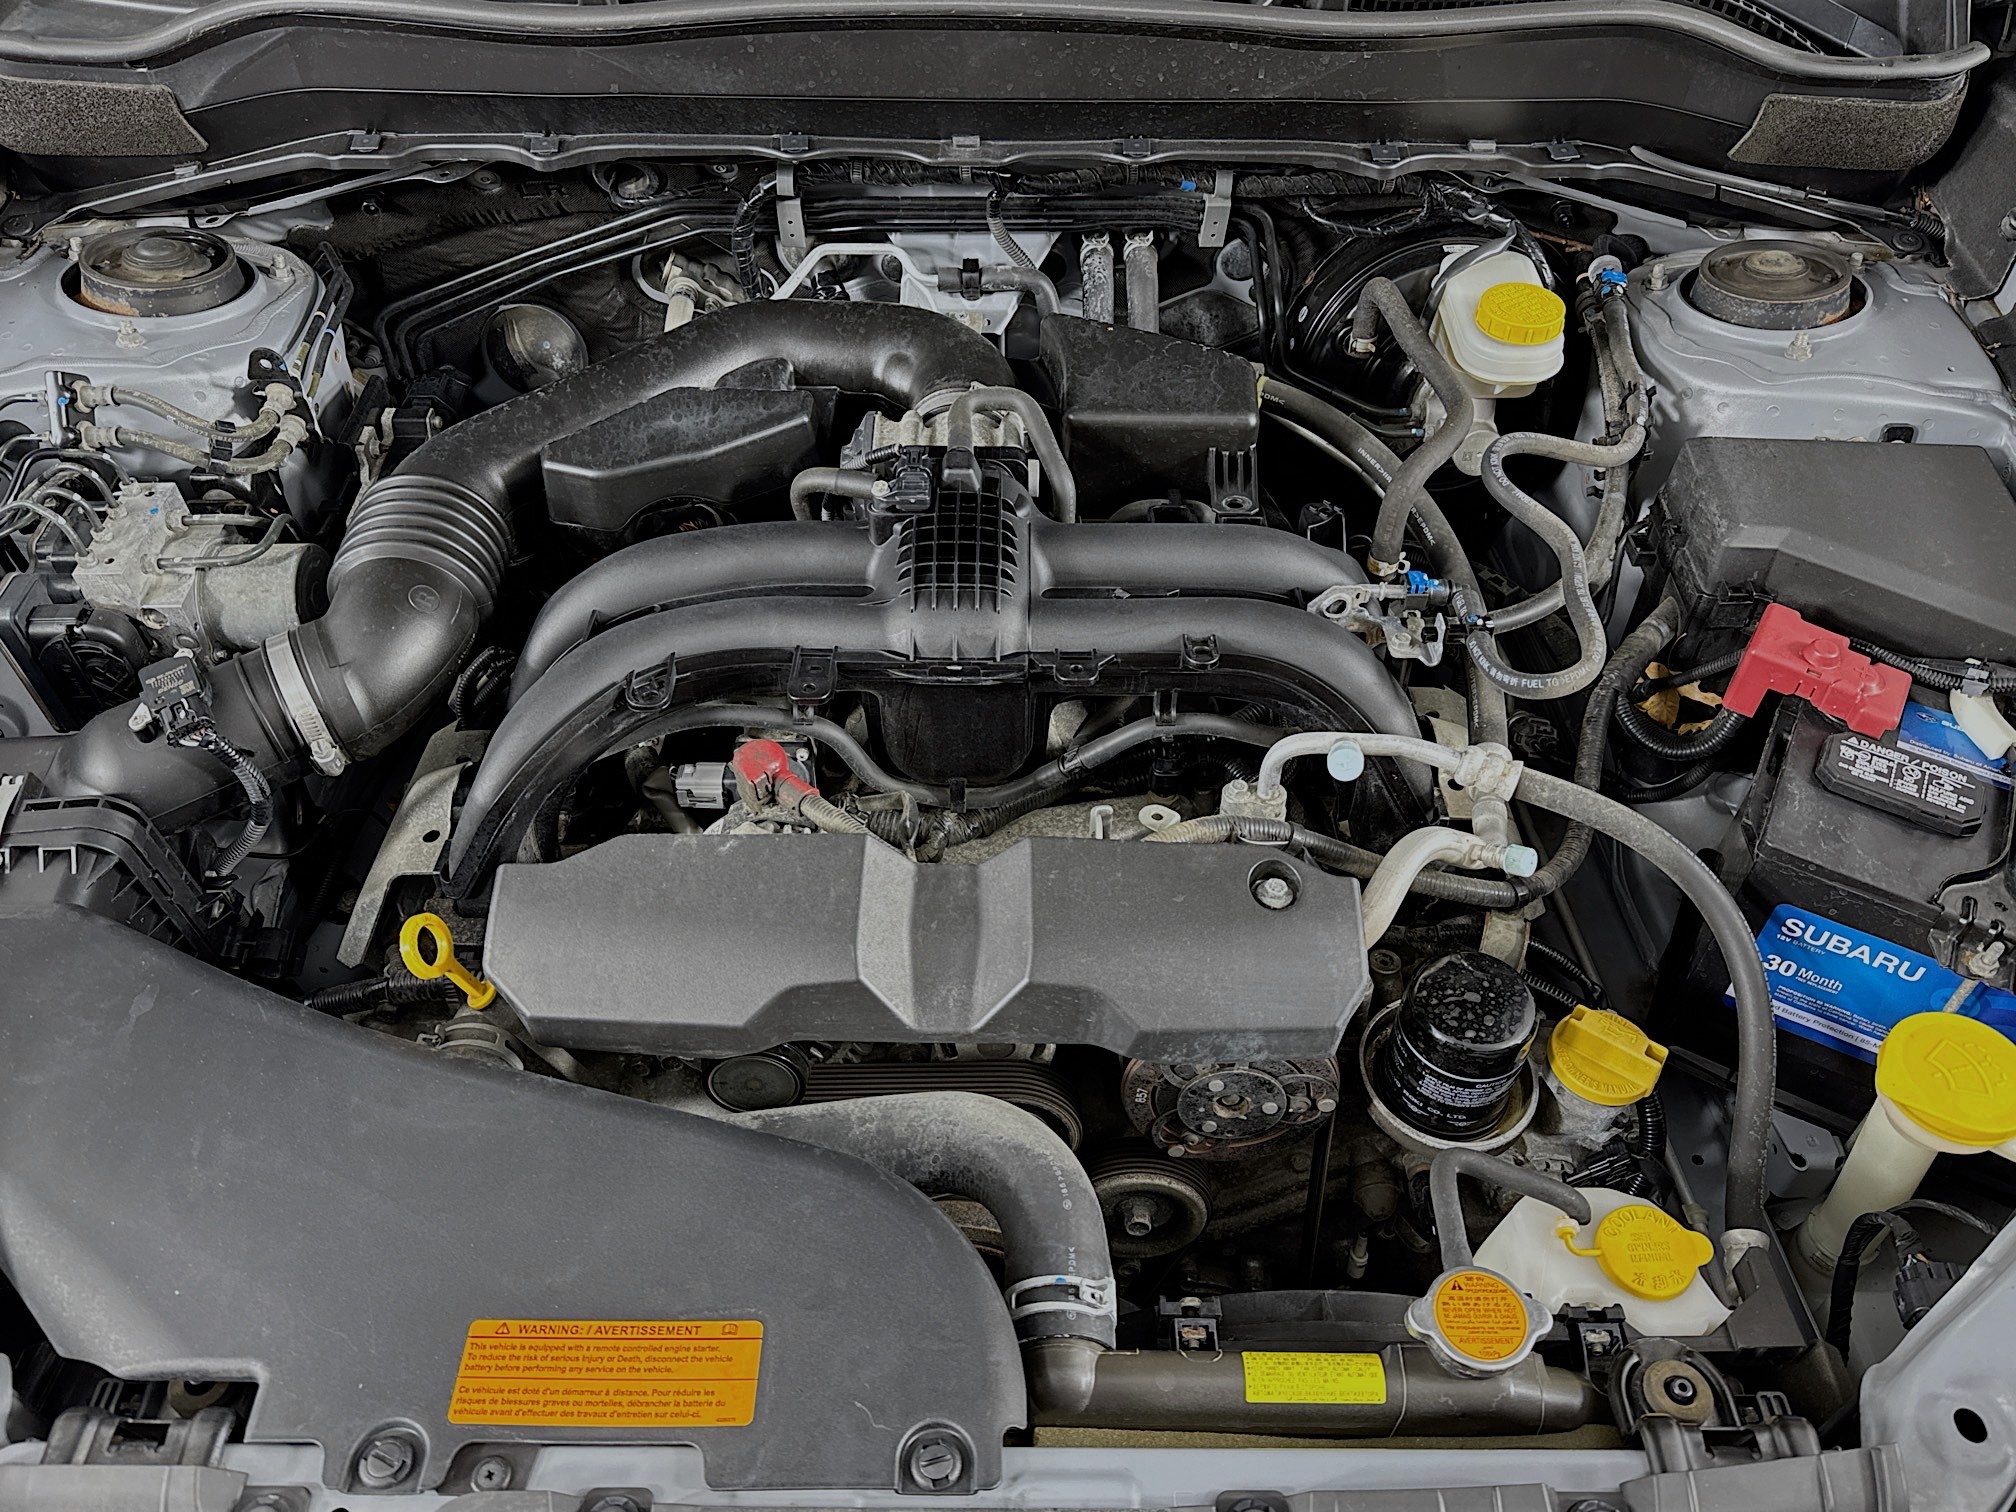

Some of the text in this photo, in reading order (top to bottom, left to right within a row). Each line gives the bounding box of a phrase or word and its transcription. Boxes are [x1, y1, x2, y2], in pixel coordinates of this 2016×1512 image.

[1521, 678, 1544, 689] FUEL
[1546, 676, 1560, 687] TG
[1860, 741, 1910, 763] DANGER
[1922, 761, 1967, 783] POISON
[1776, 933, 1826, 956] 12V BATTERY
[1781, 918, 1927, 982] SUBARU
[1763, 954, 1843, 992] 30 Month
[1781, 1006, 1811, 1023] Battery
[1812, 1018, 1854, 1040] Protection
[1556, 1047, 1637, 1094] SEE OWNER'S MANUAL
[1603, 1208, 1682, 1238] COOLANT
[1630, 1253, 1673, 1263] MANUAL
[518, 1325, 583, 1335] WARNING:
[594, 1325, 702, 1336] AVERTISSEMENT
[469, 1342, 486, 1351] This
[489, 1343, 517, 1351] vehicle
[528, 1344, 566, 1354] equipped
[568, 1344, 584, 1352] with
[622, 1345, 663, 1353] controlled
[664, 1345, 692, 1354] engine
[467, 1353, 476, 1361] To
[479, 1353, 506, 1361] reduce
[540, 1354, 549, 1362] of
[551, 1354, 579, 1362] serious
[617, 1355, 642, 1364] Death,
[645, 1355, 689, 1363] disconnect
[705, 1355, 733, 1363] vehicle
[464, 1363, 491, 1372] battery
[495, 1364, 523, 1372] before
[525, 1364, 566, 1374] performing
[568, 1366, 582, 1374] any
[643, 1366, 674, 1374] vehicle.
[458, 1386, 469, 1394] Ce
[472, 1386, 505, 1394] véhicule
[522, 1387, 540, 1395] doté
[542, 1387, 560, 1395] d'un
[562, 1388, 603, 1396] démarreur
[613, 1388, 649, 1397] distance.
[456, 1397, 486, 1406] risques
[489, 1397, 498, 1405] de
[501, 1397, 540, 1406] blessures
[543, 1399, 570, 1408] graves
[560, 1409, 574, 1417] des
[577, 1410, 607, 1418] travaux
[609, 1410, 653, 1418] d'entretien
